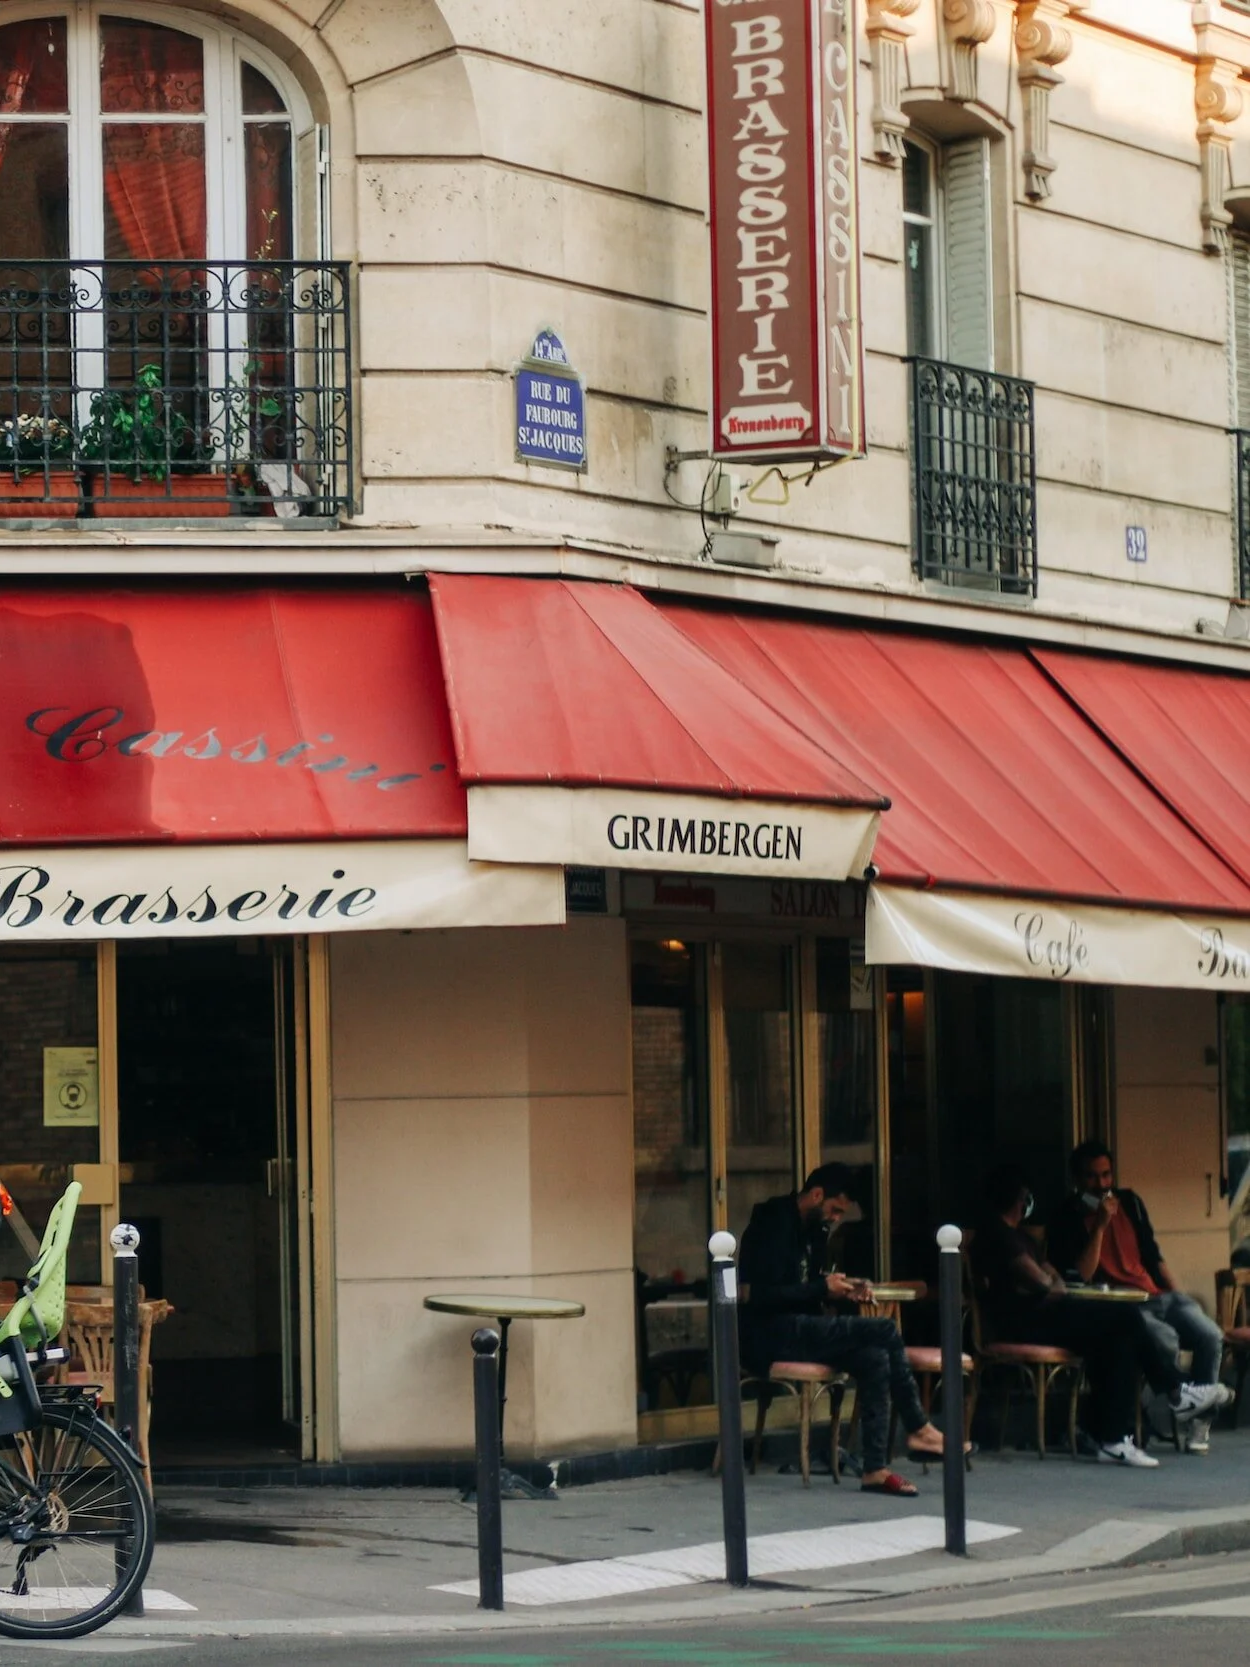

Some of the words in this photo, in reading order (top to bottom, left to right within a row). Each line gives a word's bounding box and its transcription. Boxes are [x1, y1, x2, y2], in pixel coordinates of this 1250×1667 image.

[730, 15, 793, 397] BRASSERIE
[824, 41, 854, 434] CASSINI
[530, 380, 552, 402] RUE
[556, 385, 571, 404] DU
[525, 404, 578, 429] FAUBOURG
[728, 414, 805, 434] Kronenbourg
[1128, 528, 1145, 559] 32
[25, 706, 446, 791] Cassini
[607, 814, 802, 861] GRIMBERGEN
[770, 881, 840, 918] SALON
[1014, 912, 1090, 979] Café
